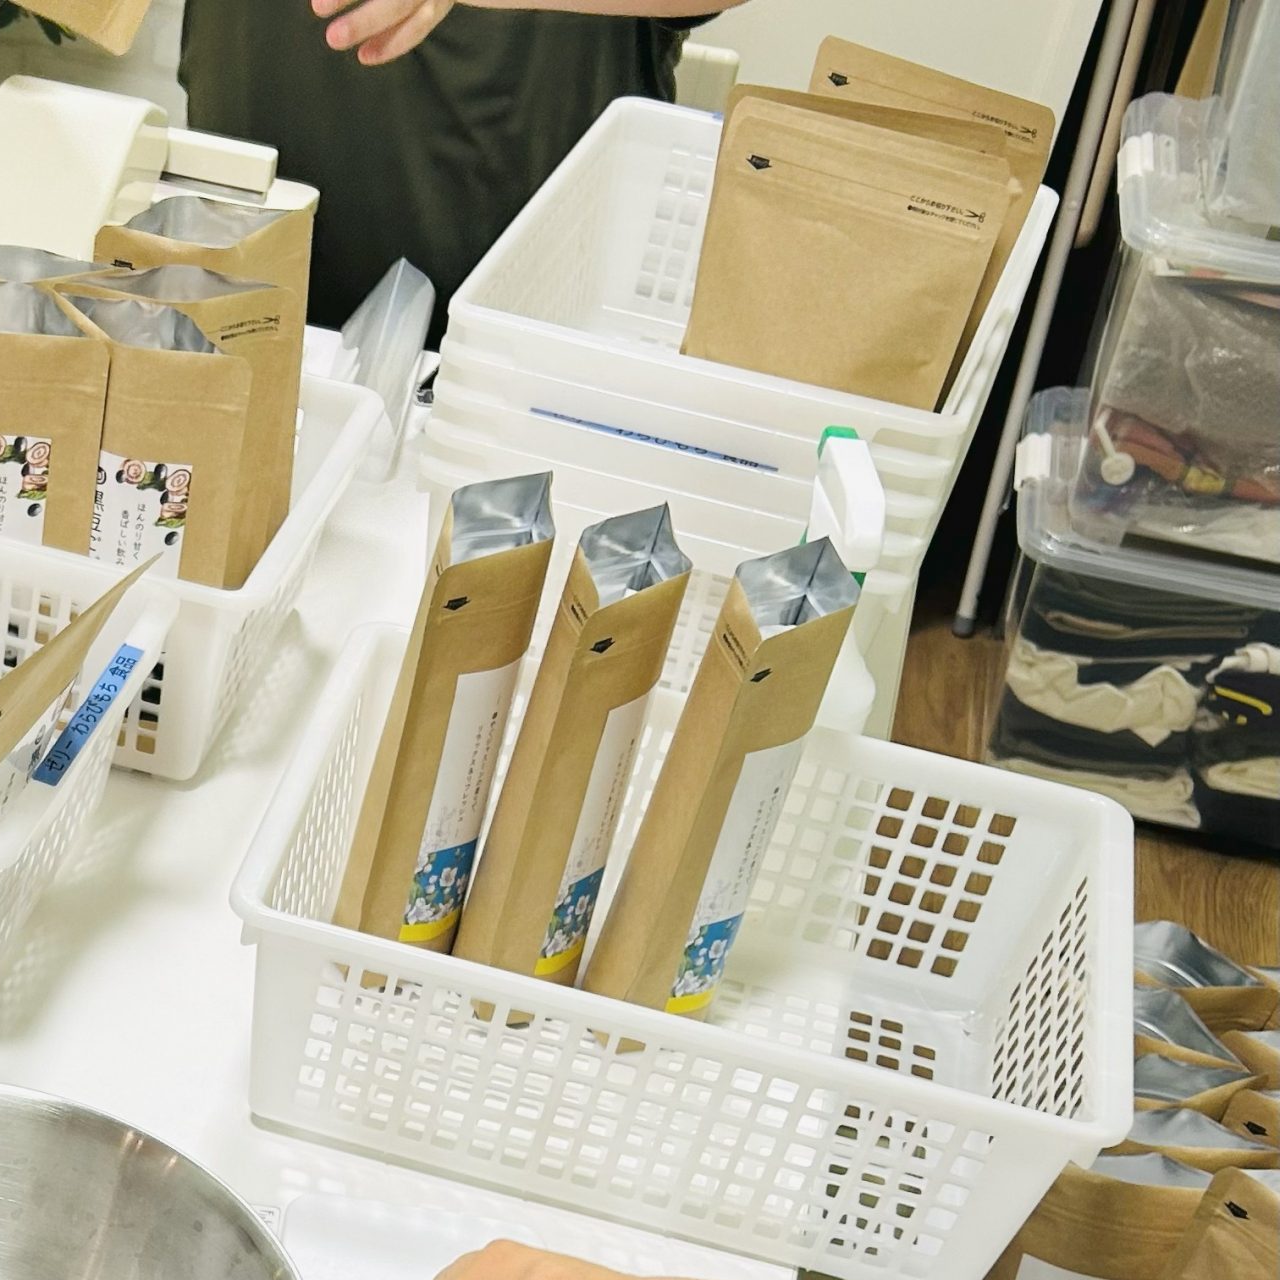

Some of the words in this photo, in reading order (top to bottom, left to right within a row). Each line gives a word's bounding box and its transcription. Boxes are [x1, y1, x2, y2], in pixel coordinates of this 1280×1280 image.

[71, 682, 118, 736] わらびもち
[108, 655, 137, 681] 食品
